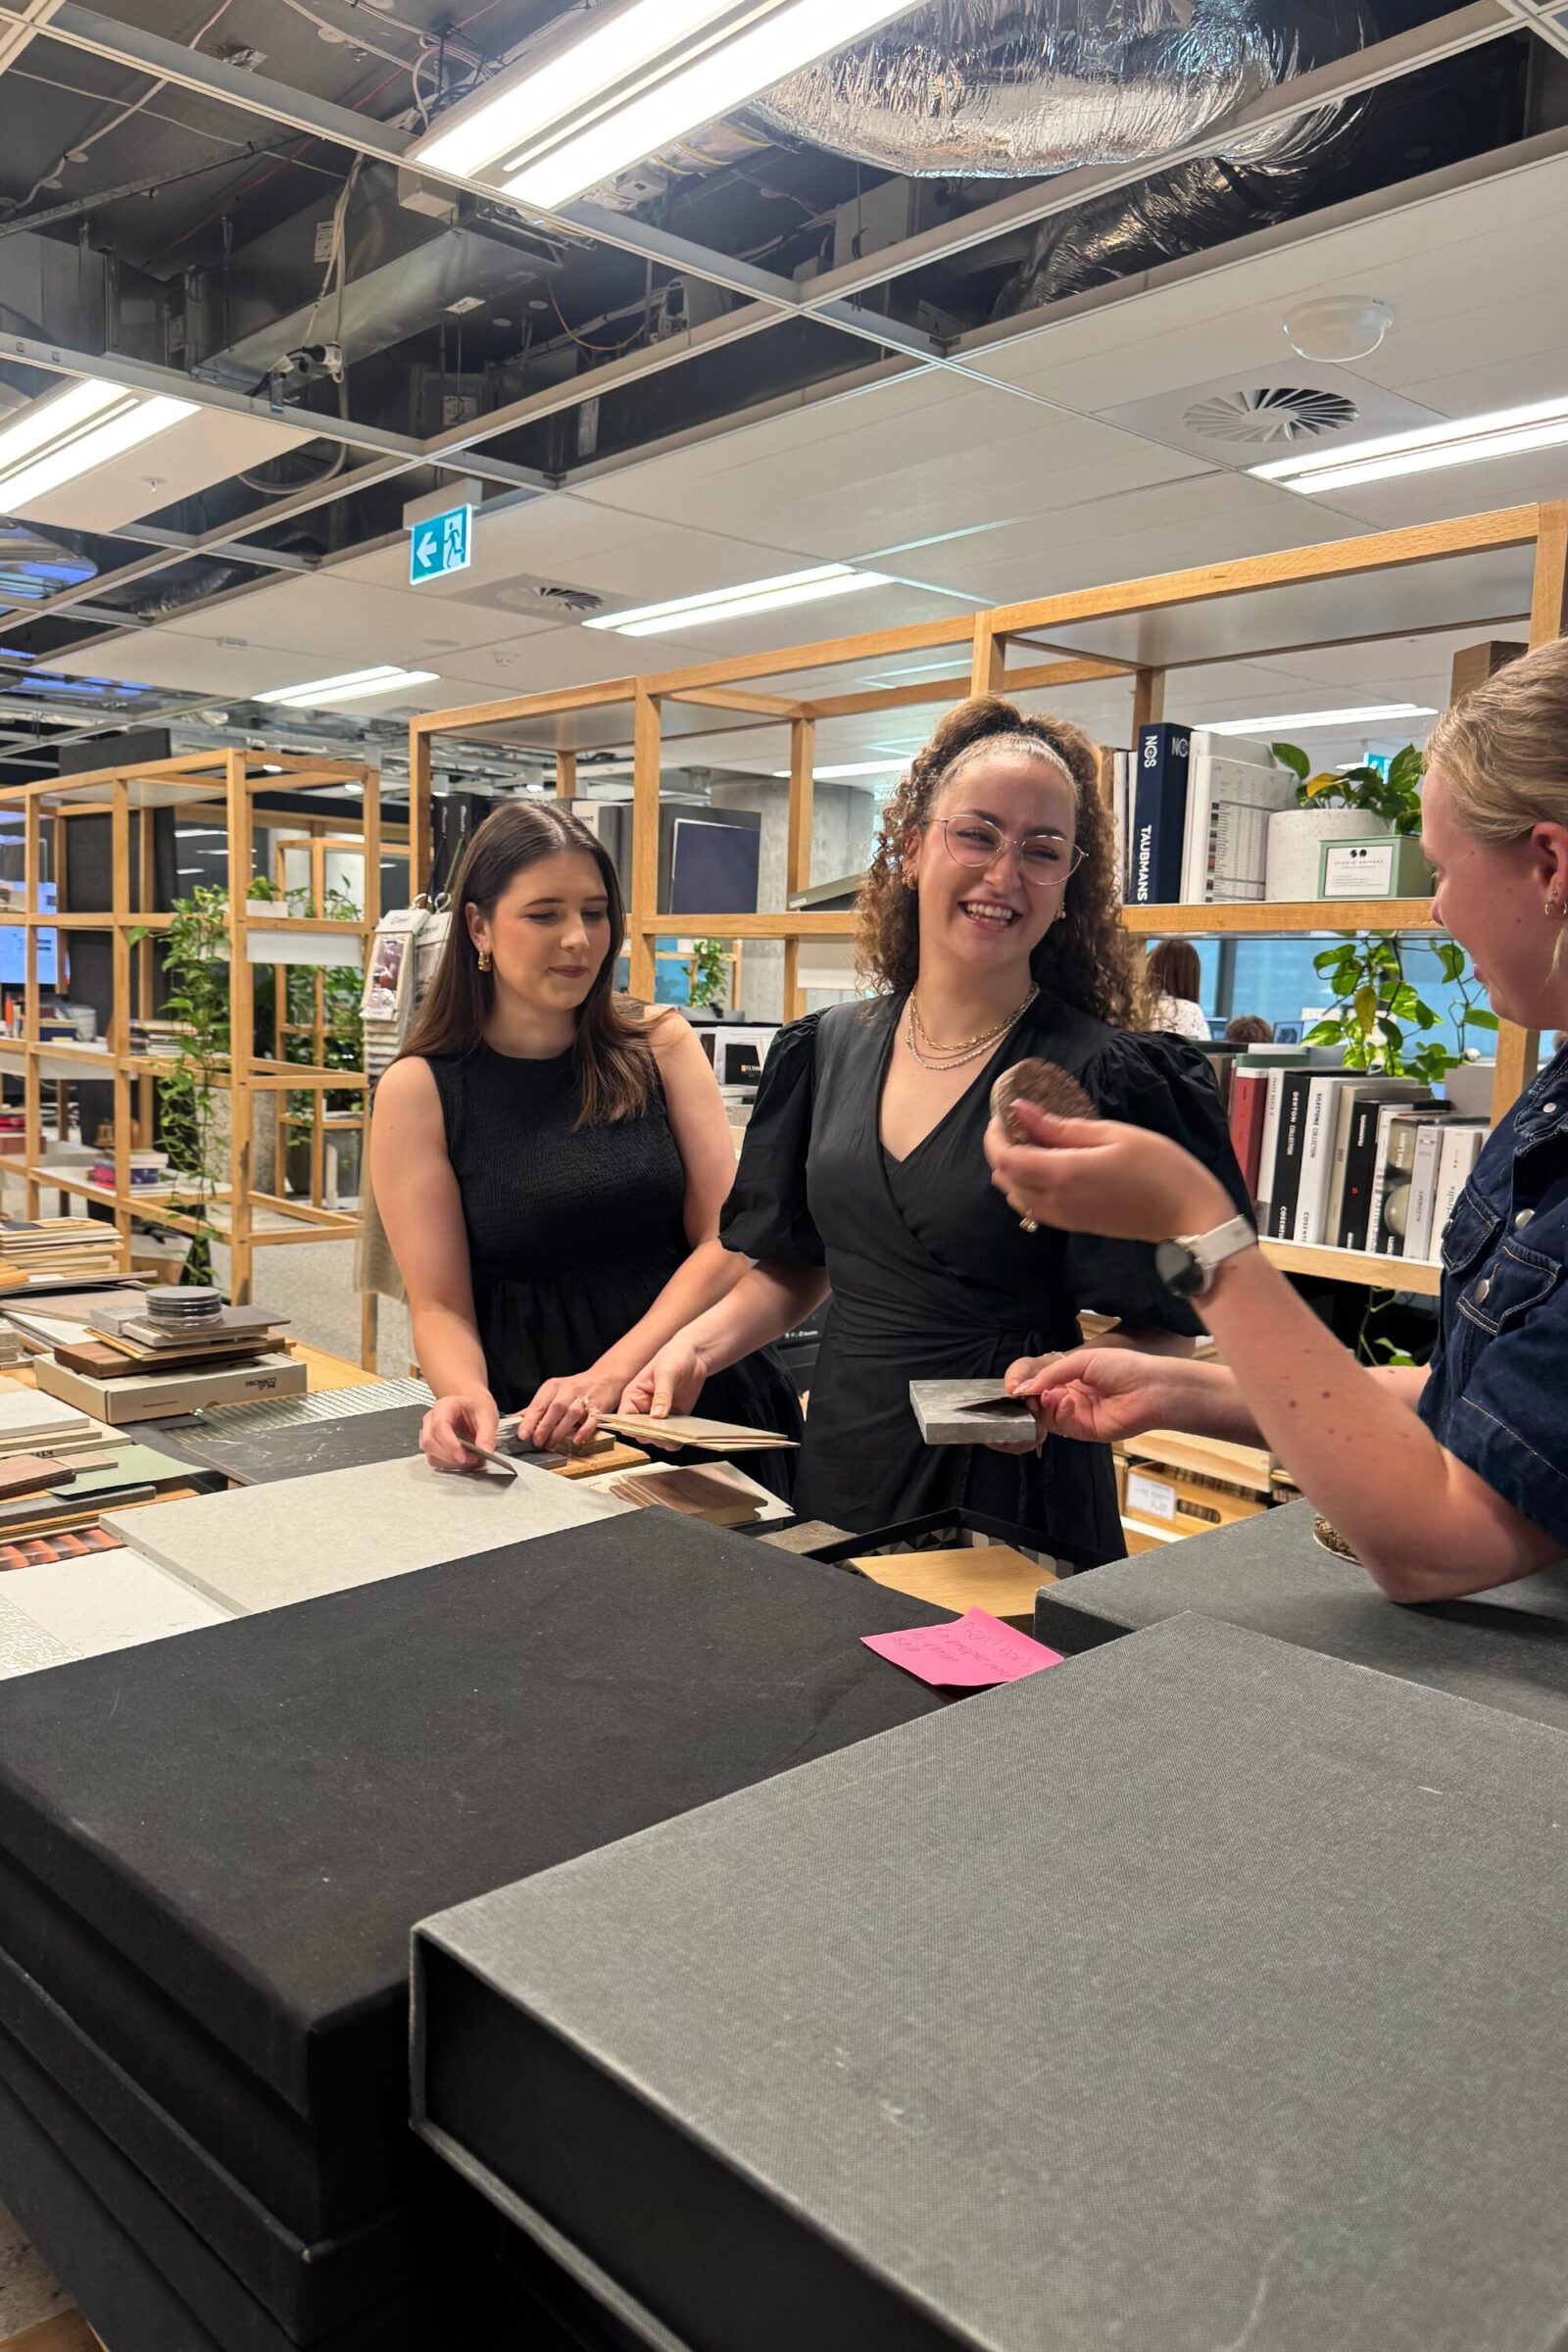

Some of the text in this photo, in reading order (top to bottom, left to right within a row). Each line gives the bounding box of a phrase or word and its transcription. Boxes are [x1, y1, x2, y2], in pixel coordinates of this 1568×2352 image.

[1144, 735, 1158, 768] NOS
[1172, 737, 1189, 758] NO
[1137, 824, 1152, 902] TAUBMANS
[1287, 1091, 1299, 1156] DEKTON COLLECTION
[1310, 1093, 1322, 1158] SILESTONE COLLECTION
